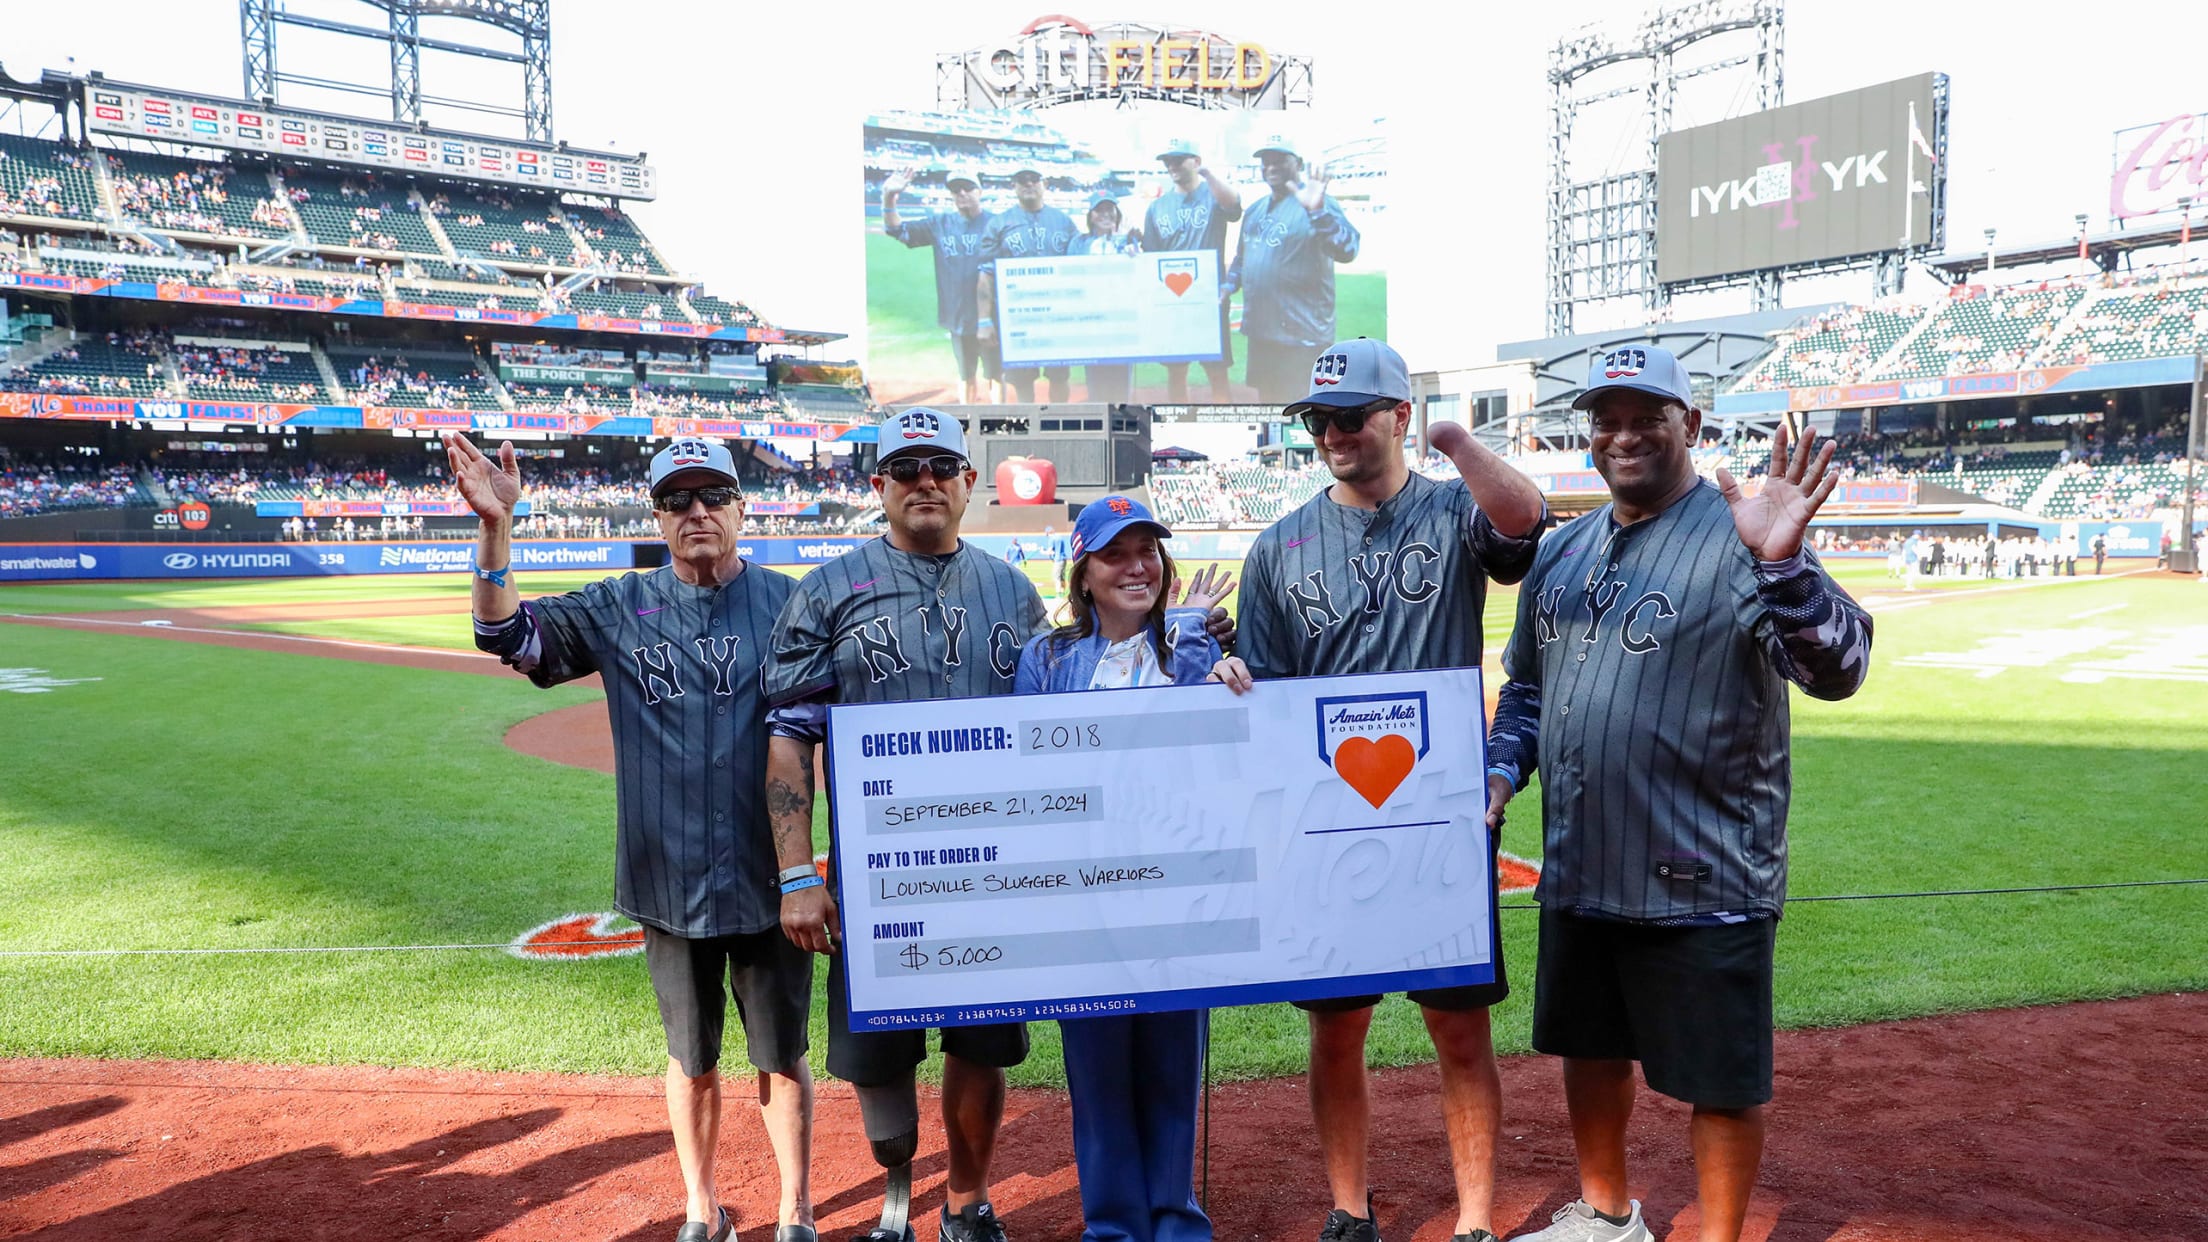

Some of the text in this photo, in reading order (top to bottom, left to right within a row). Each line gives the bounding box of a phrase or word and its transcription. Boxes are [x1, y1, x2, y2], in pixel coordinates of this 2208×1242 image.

[980, 28, 1272, 90] citi FIELD
[98, 95, 118, 104] PIT
[99, 110, 121, 119] CIN
[194, 110, 216, 119] ATL
[146, 117, 171, 125] CHC
[241, 117, 258, 125] AZ
[285, 136, 305, 144] STL
[365, 134, 386, 142] COL
[365, 145, 386, 154] LAD
[444, 144, 464, 152] TOR
[406, 151, 427, 160] BAL
[448, 156, 461, 164] TB
[588, 163, 606, 171] LAA
[1690, 150, 1888, 217] IYK YK
[243, 293, 271, 304] YOU
[457, 308, 481, 319] YOU
[512, 368, 585, 381] THE PORCH
[1904, 380, 1943, 397] YOU
[1954, 376, 2015, 393] FANS!
[72, 402, 129, 412] THANK
[141, 402, 183, 417] YOU
[193, 404, 254, 420] FANS!
[475, 413, 508, 427] YOU
[517, 416, 564, 429] FANS!
[744, 423, 770, 435] YOU
[384, 503, 409, 513] YOU
[154, 512, 178, 524] citi
[184, 511, 207, 521] 103
[202, 554, 290, 568] HYUNDAI
[319, 553, 345, 565] 358
[402, 546, 471, 564] National
[523, 546, 609, 564] Northwell
[1, 556, 78, 570] smartwater
[426, 563, 469, 571] Car Rental
[1286, 541, 1440, 638] NYC
[1536, 581, 1677, 656] NYC
[851, 603, 1022, 683] NYC
[1329, 704, 1415, 725] Amazin' Mets
[1331, 721, 1417, 733] FOUNDATION
[861, 723, 1102, 758] CHECK NUMBER: 2018
[863, 780, 893, 797] DATE
[884, 793, 1088, 826] SEPTEMBER 21, 2024
[867, 846, 999, 869] PAY TO THE ORDER OF
[880, 865, 1164, 900] LOUISVILLE SLUGGER WARRIORS
[873, 921, 924, 940] AMOUNT
[899, 943, 1003, 971] $ 5,000
